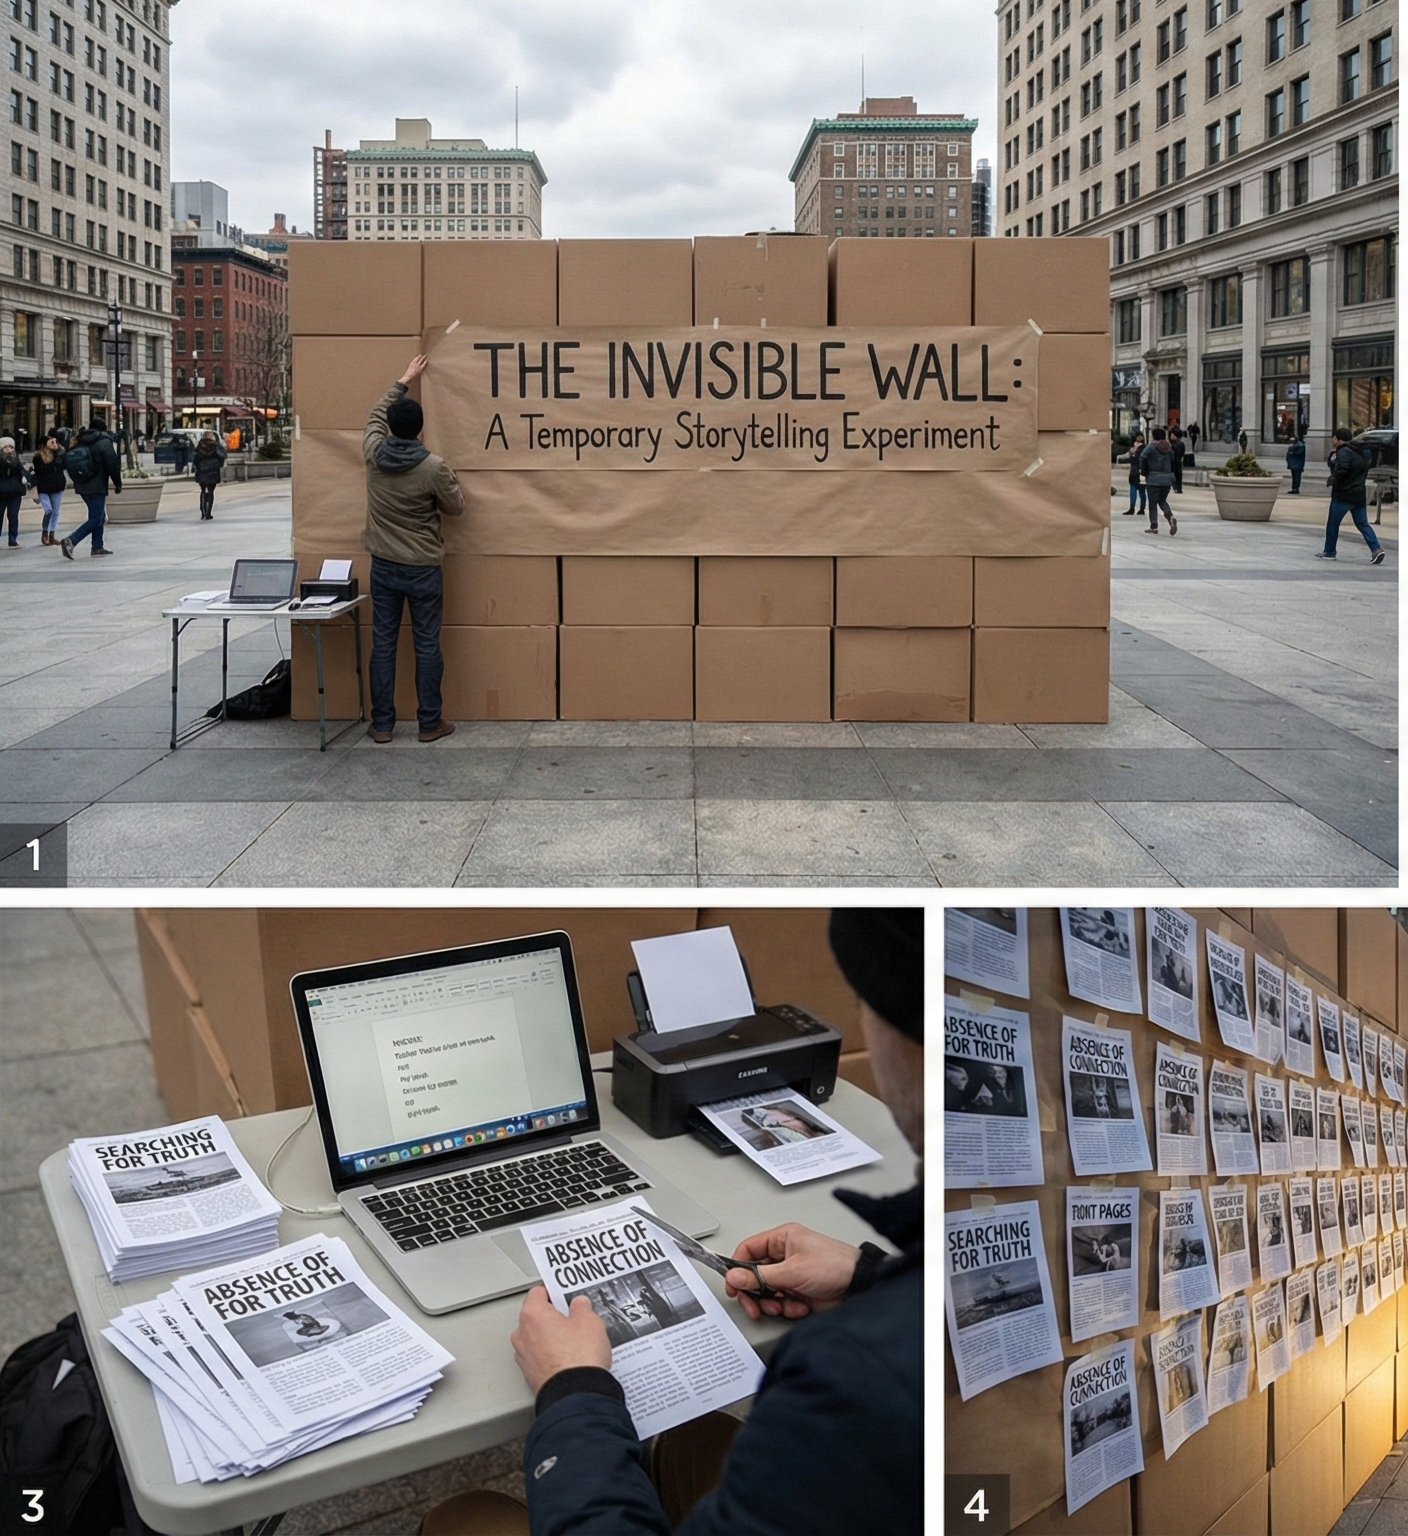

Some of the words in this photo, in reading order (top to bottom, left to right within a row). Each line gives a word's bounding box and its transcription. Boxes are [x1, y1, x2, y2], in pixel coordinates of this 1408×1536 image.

[473, 341, 581, 400] THE
[608, 340, 846, 400] INVISIBLE
[867, 343, 1023, 402] WALL:
[485, 413, 509, 450] A
[520, 413, 663, 464] Temporary
[674, 410, 829, 463] Storytelling
[842, 411, 1001, 460] Experiment
[972, 1038, 1015, 1062] TRUTH
[1001, 1026, 1018, 1044] OF
[1112, 1044, 1124, 1060] OF
[95, 1128, 212, 1159] SEARCHING
[102, 1155, 146, 1171] FOR
[147, 1140, 217, 1164] TRUTH
[545, 1228, 624, 1268] ABSENCE
[623, 1220, 647, 1243] OF
[948, 1220, 1031, 1252] SEARCHING
[554, 1239, 666, 1289] CONNECTION
[951, 1248, 981, 1273] FOR
[982, 1239, 1032, 1265] TRUTH
[204, 1262, 303, 1305] ABSENCE
[302, 1251, 329, 1271] OF
[213, 1294, 267, 1321] FOR
[263, 1266, 346, 1305] TRUTH
[1113, 1355, 1126, 1371] OF
